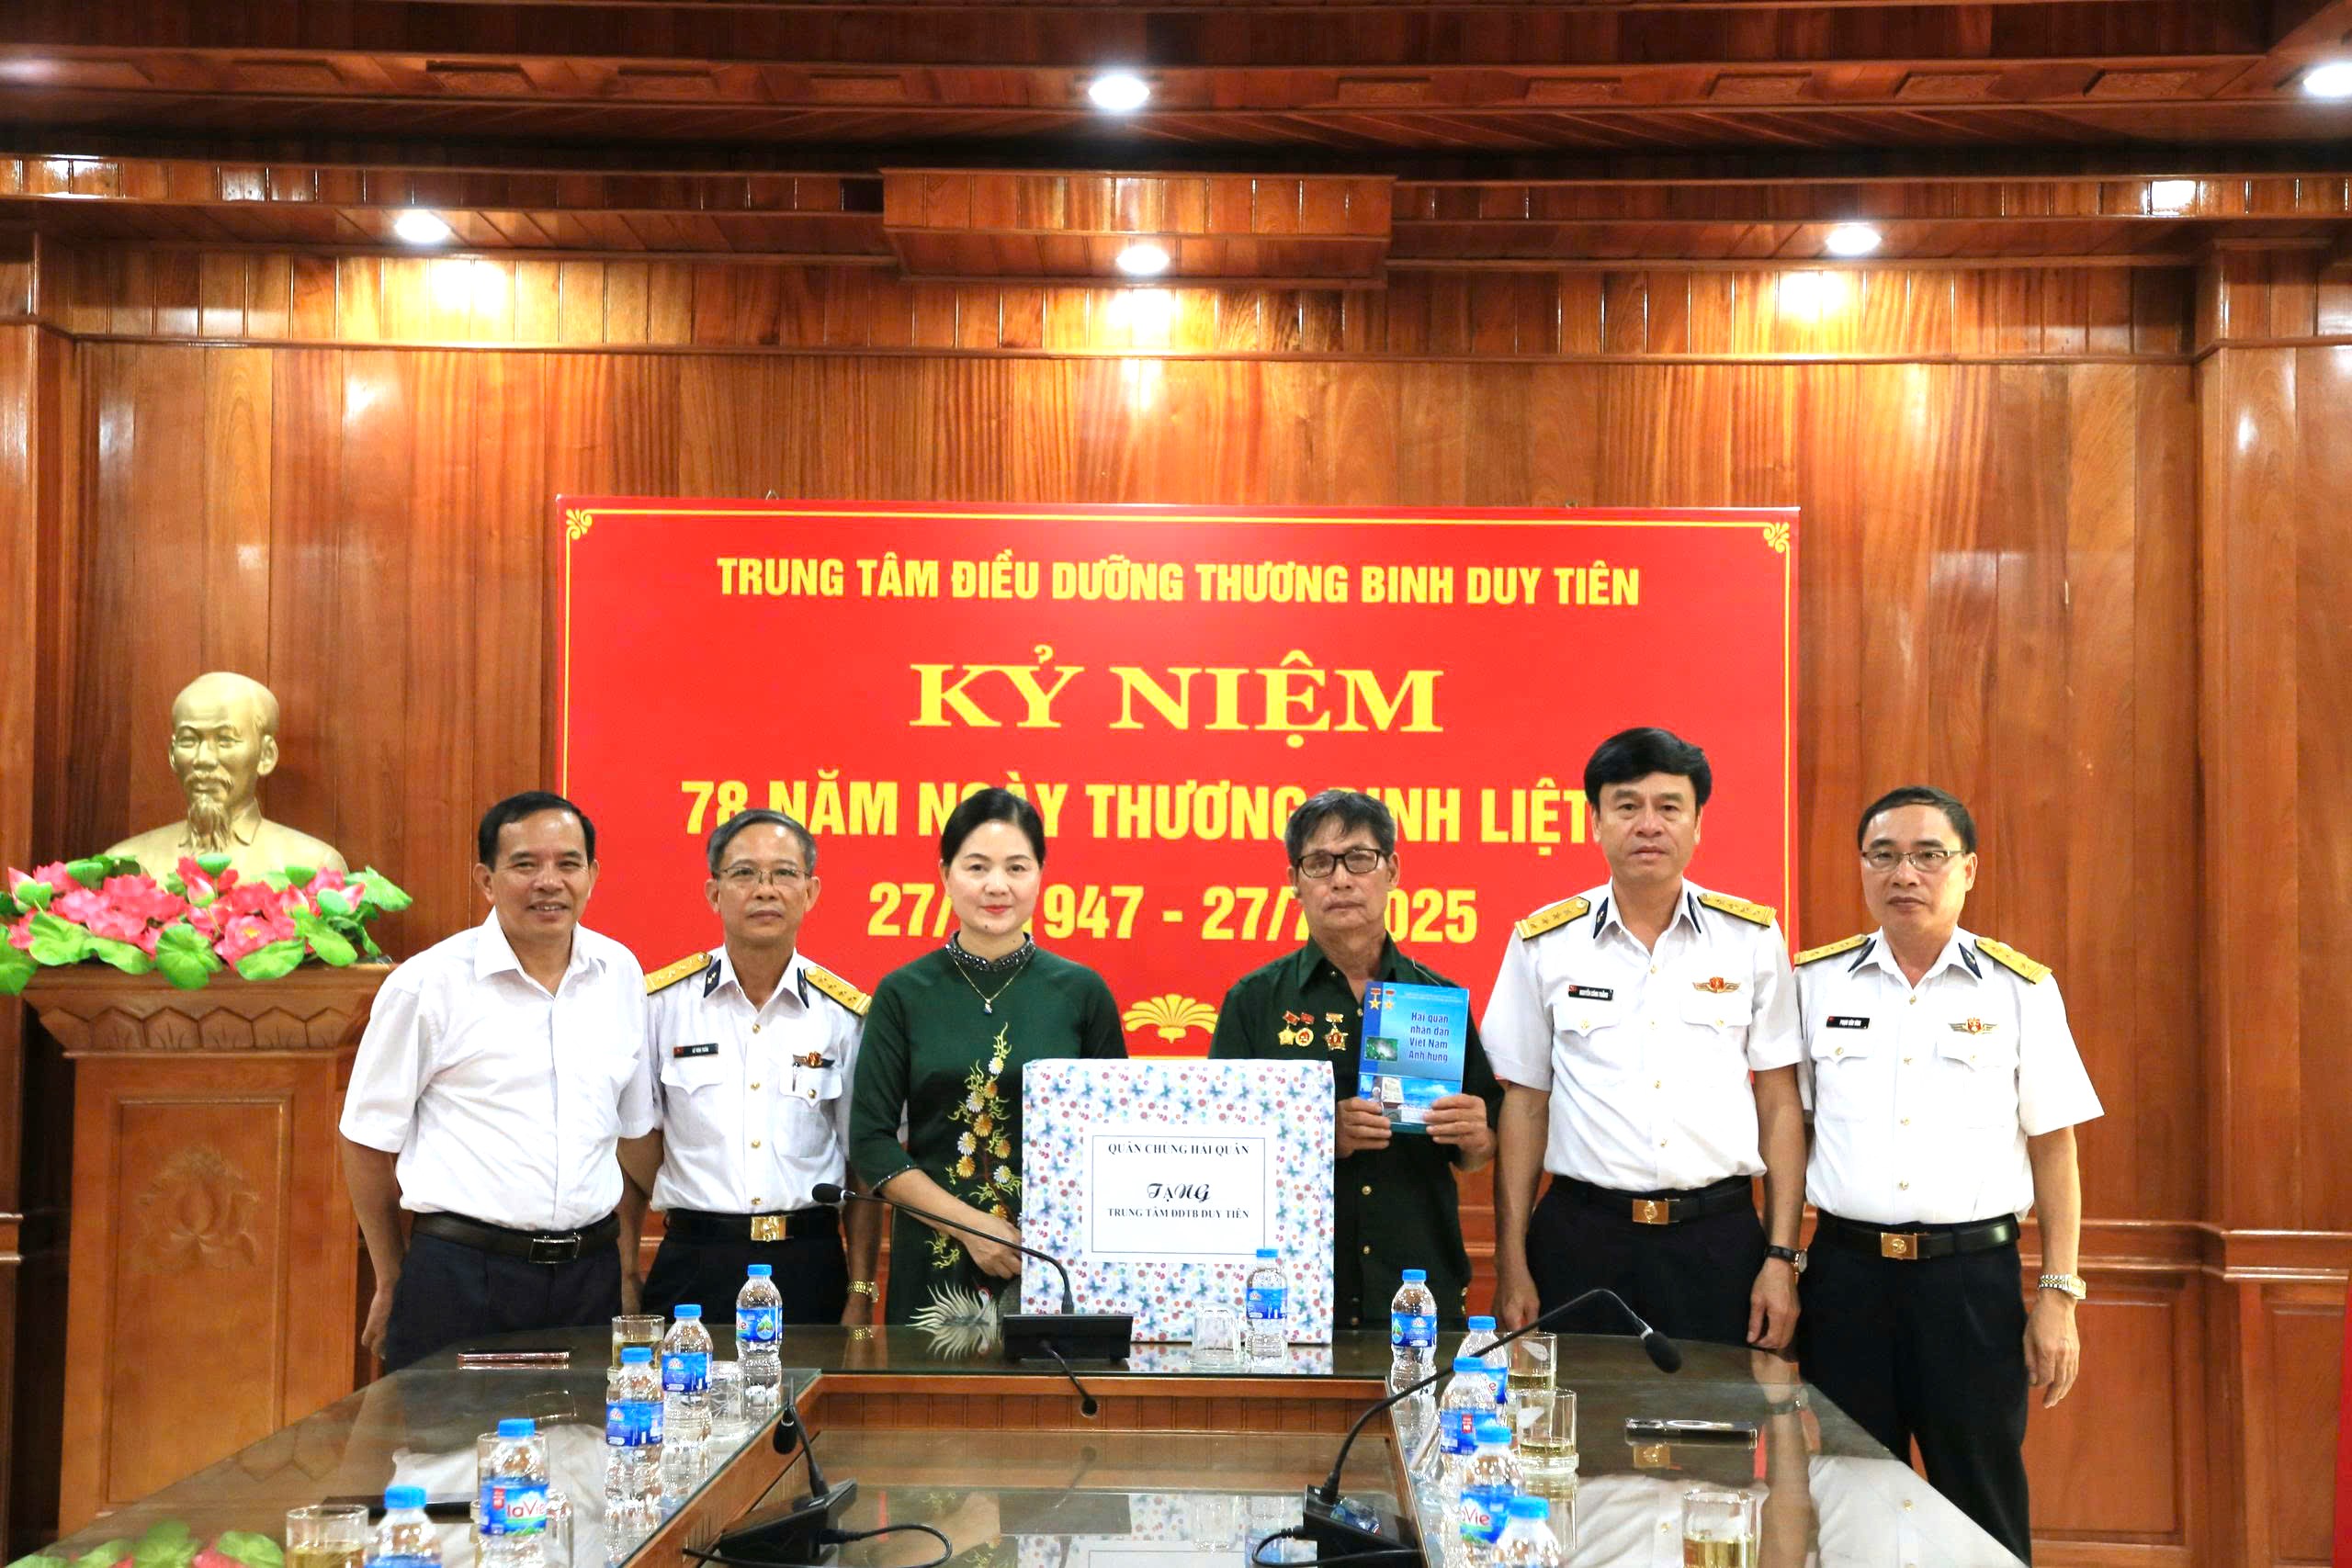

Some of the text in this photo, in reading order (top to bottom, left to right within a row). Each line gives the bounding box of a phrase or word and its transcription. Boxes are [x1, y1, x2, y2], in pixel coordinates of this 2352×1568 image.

[717, 548, 1640, 606] TRUNG TÂM ĐIỀU DƯỠNG THƯƠNG BINH DUY TIÊN
[909, 644, 1444, 749] KỶ NIỆM
[768, 769, 899, 836] NĂM
[1481, 776, 1589, 856] LIỆT
[1108, 1208, 1143, 1217] TRUNG
